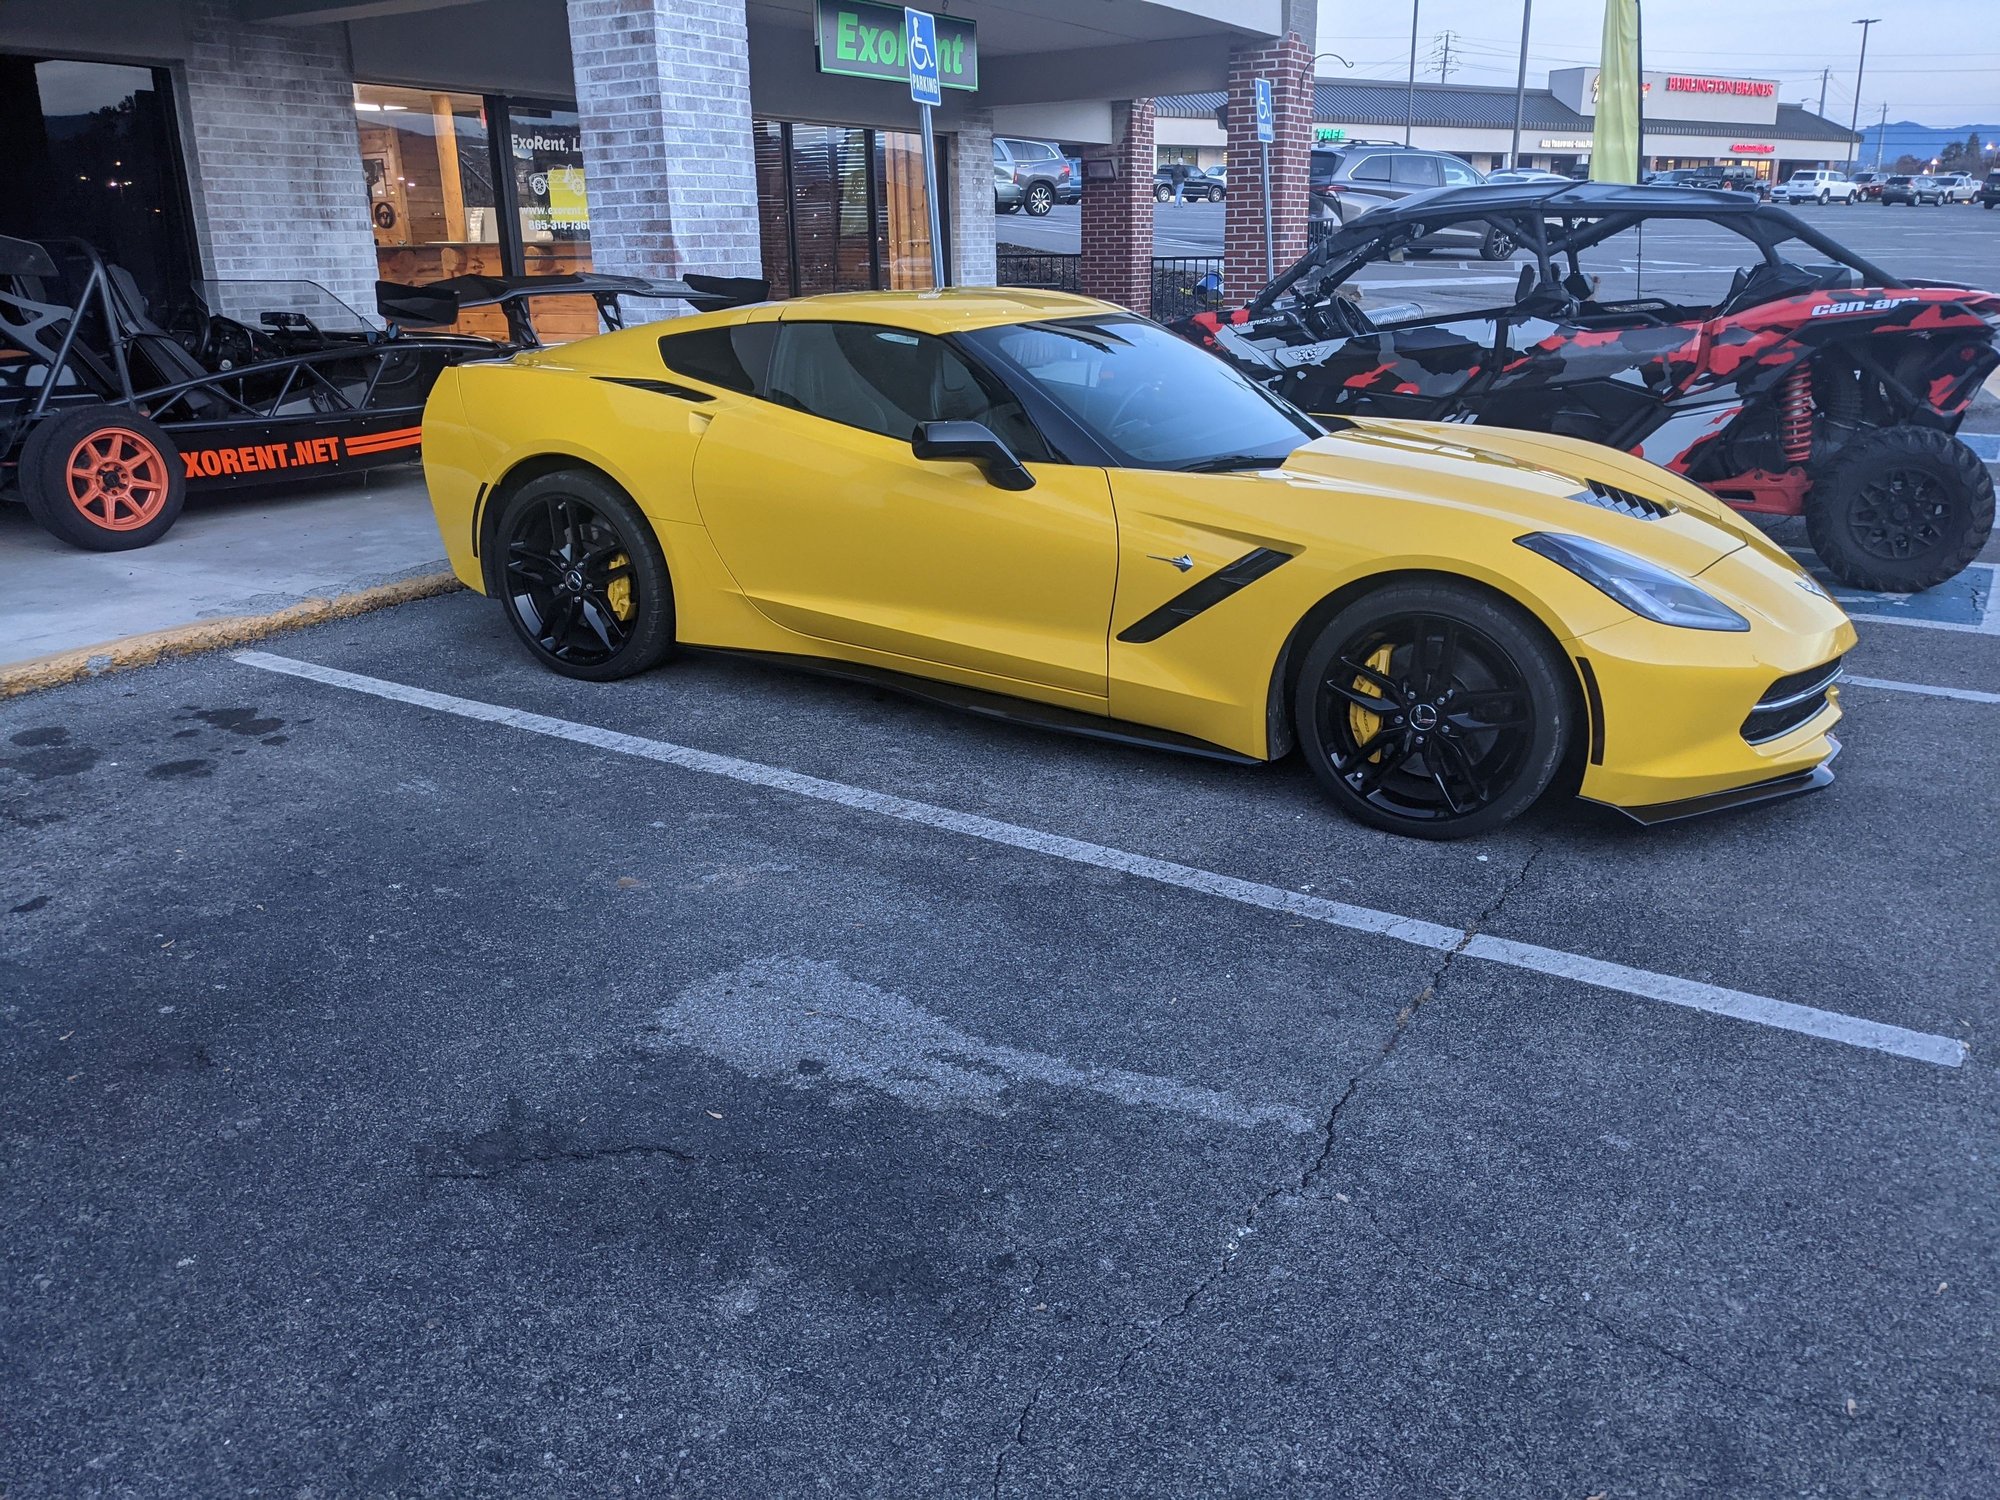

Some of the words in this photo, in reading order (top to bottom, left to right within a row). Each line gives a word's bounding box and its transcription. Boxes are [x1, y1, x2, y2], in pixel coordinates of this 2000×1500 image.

[837, 11, 964, 74] Exont
[912, 73, 938, 94] PARKING
[1667, 77, 1733, 94] BURLINGTON
[1734, 82, 1773, 97] BRANDS
[511, 134, 568, 154] ExoRent,
[573, 138, 582, 151] L
[1233, 317, 1272, 328] MAVERICK
[1272, 315, 1285, 323] X3
